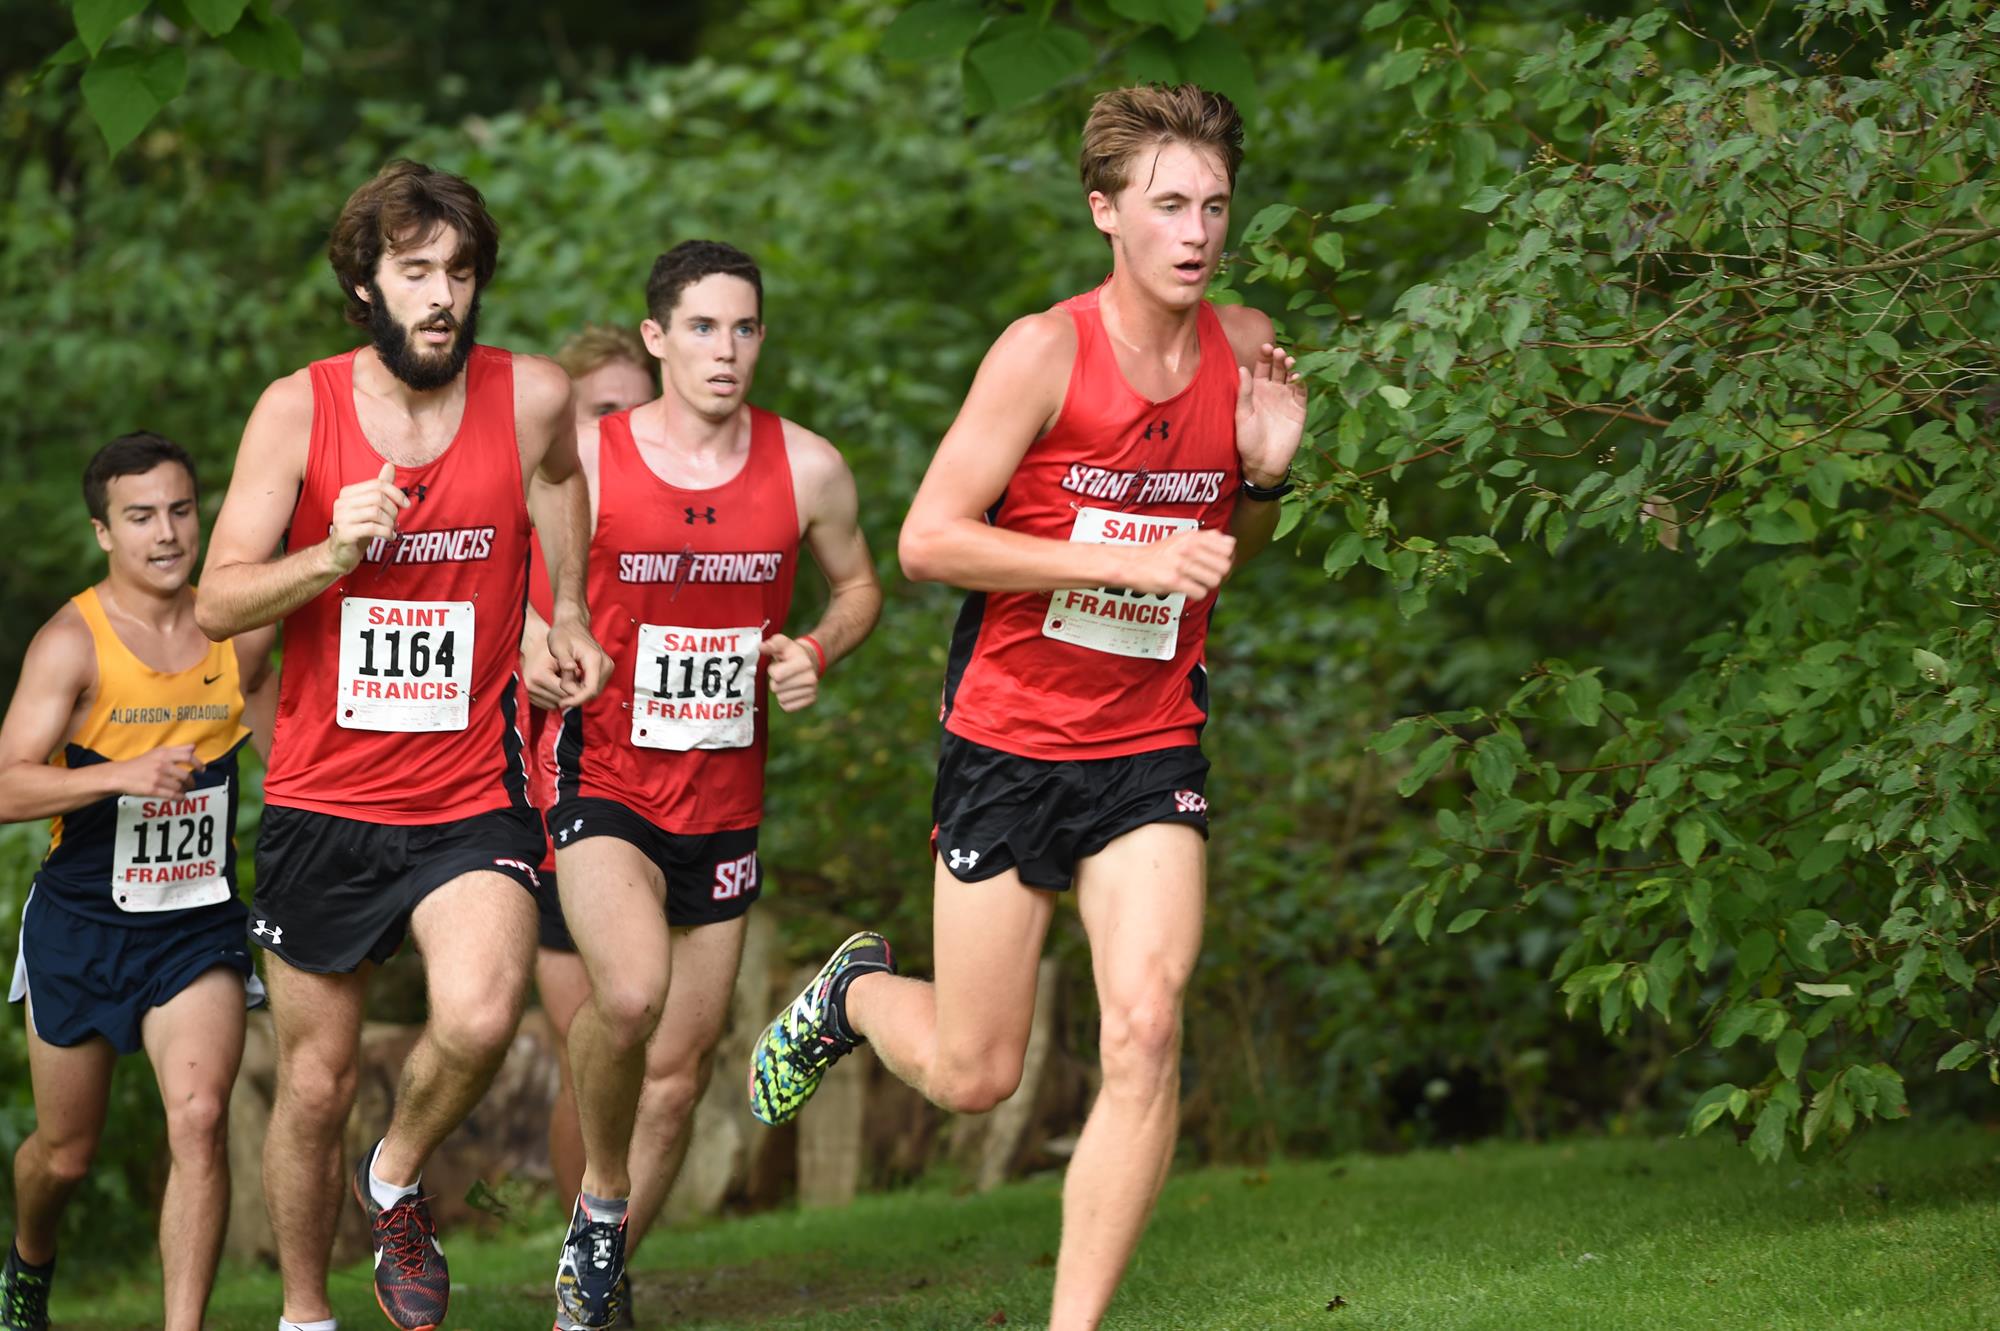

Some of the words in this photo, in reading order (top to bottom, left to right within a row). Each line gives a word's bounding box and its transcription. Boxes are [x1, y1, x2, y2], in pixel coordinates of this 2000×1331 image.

[1061, 463, 1138, 500] SAINT
[1136, 471, 1226, 503] FRANCIS
[394, 527, 496, 562] FRANCIS
[1101, 519, 1178, 543] SAINT
[619, 554, 681, 582] SAINT
[688, 552, 783, 582] FRANCIS
[368, 606, 450, 626] SAINT
[1064, 591, 1172, 625] FRANCIS
[359, 628, 455, 678] 1164
[663, 633, 741, 653] SAINT
[352, 679, 459, 700] FRANCIS
[652, 654, 745, 699] 1162
[645, 700, 746, 720] FRANCIS
[142, 795, 210, 819] SAINT
[131, 815, 214, 864] 1128
[125, 860, 217, 884] FRANCIS
